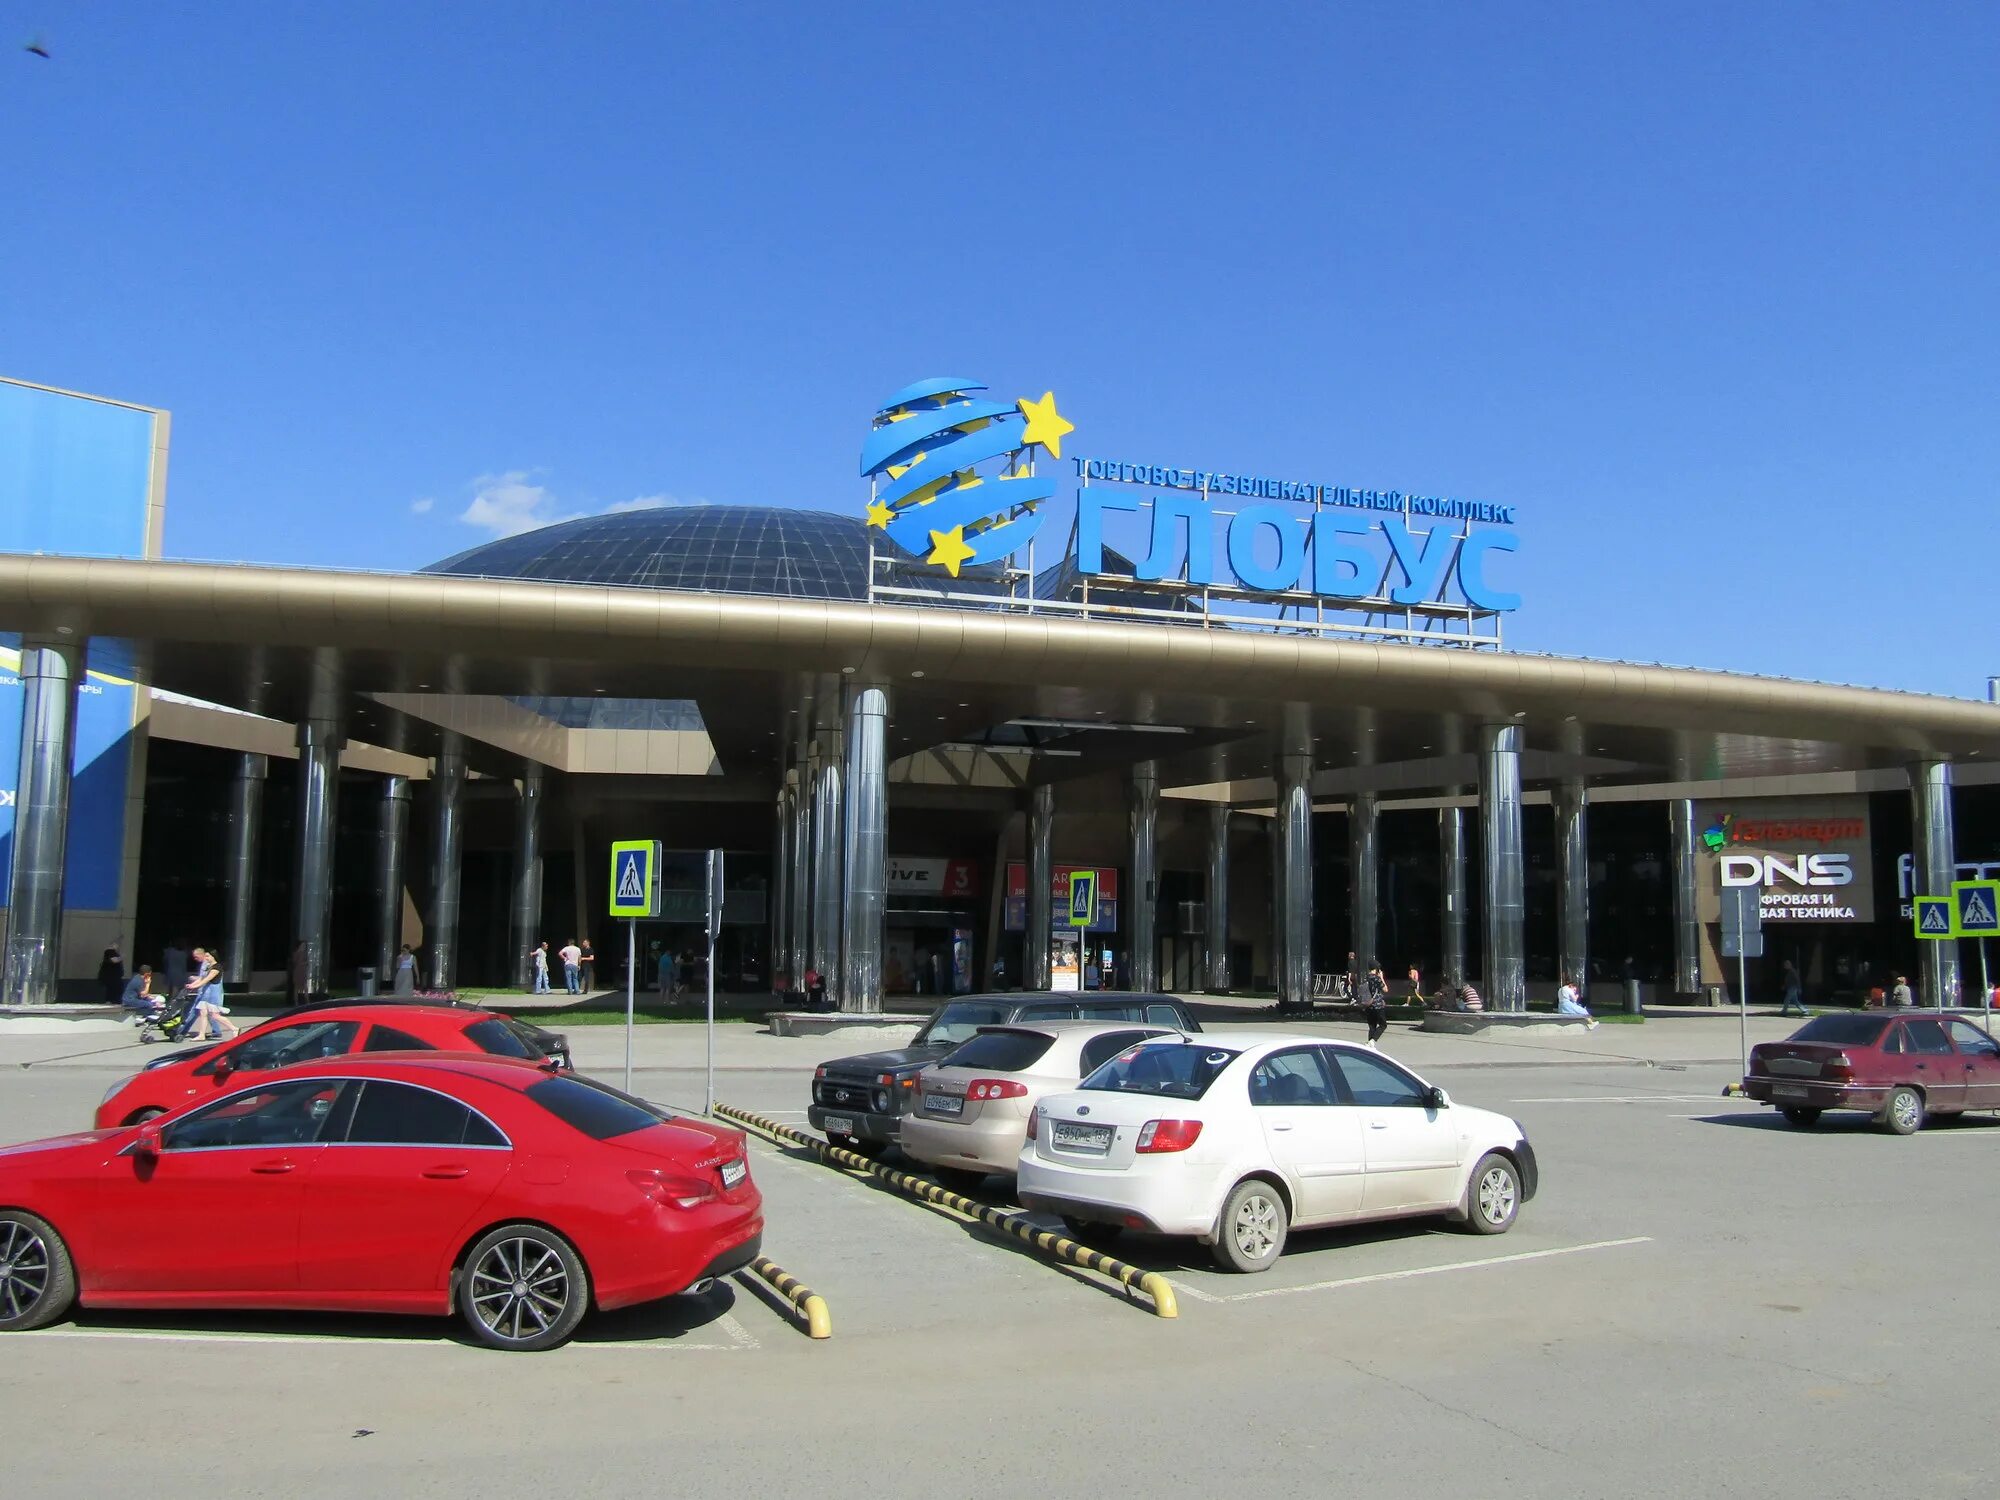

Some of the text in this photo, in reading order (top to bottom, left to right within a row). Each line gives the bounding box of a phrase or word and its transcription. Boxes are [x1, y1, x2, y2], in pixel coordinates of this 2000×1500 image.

[1072, 457, 1516, 524] ТОРГОВО-РАЗВЛЕКАТЕЛЬНЫЙ КОМПЛЕКС
[1077, 487, 1521, 611] ГЛОБУС
[954, 866, 969, 889] 3
[1720, 854, 1853, 887] DNS
[1790, 907, 1855, 918] ТЕХНИКА
[1823, 894, 1834, 905] И
